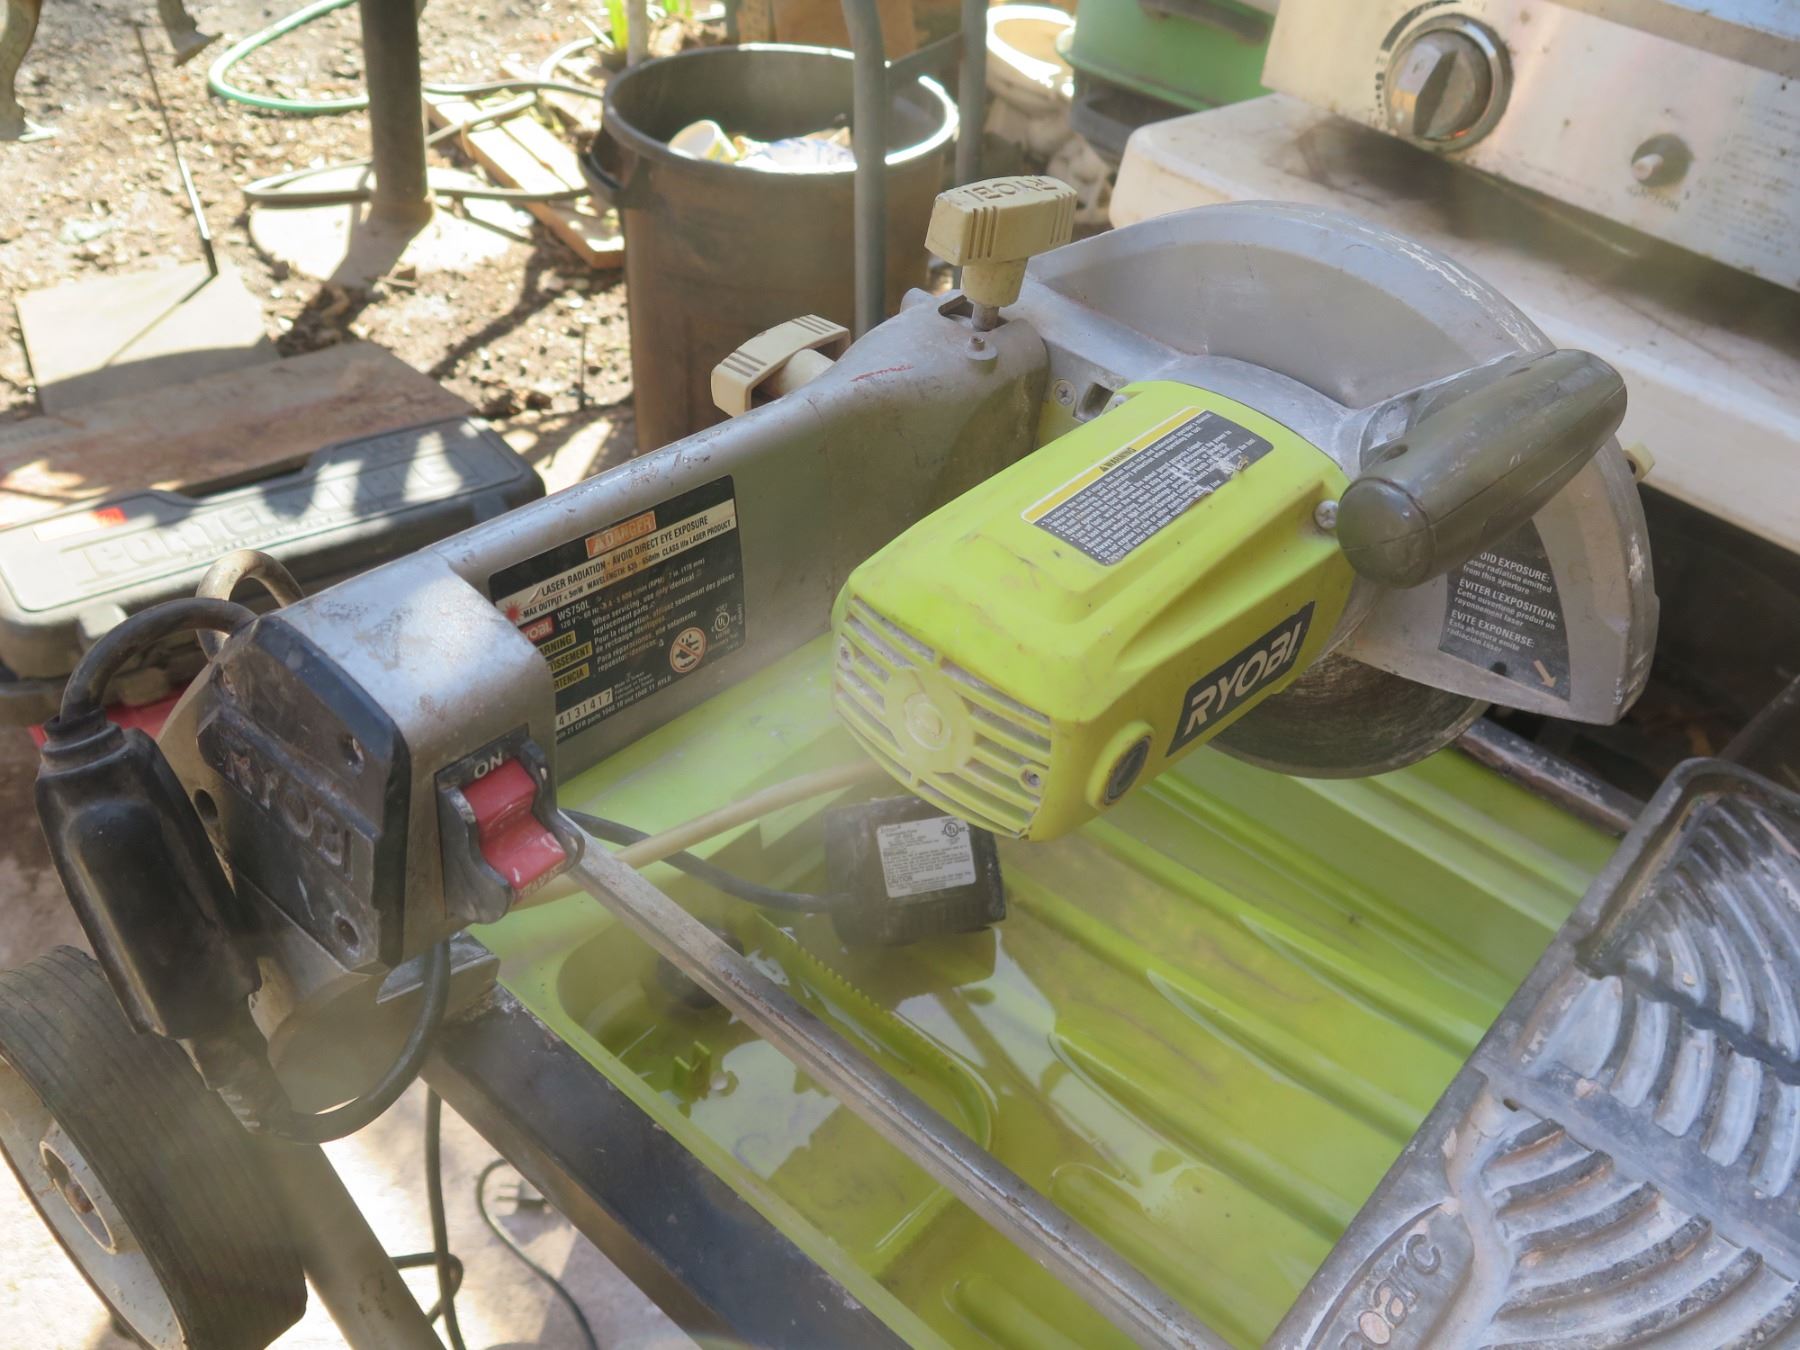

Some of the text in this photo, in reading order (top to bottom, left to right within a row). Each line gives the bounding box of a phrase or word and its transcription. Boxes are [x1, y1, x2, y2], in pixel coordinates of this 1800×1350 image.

[523, 606, 537, 617] MAX
[538, 595, 562, 610] OUTPUT
[661, 543, 679, 556] CLASS
[689, 531, 706, 543] LASER
[706, 520, 731, 535] PRODUCT
[541, 516, 708, 596] LASER RADIATION AVOID DIRECT EYE EXPOSURE
[1480, 552, 1550, 582] OID EXPOSURE:
[1463, 566, 1480, 576] from
[1482, 572, 1495, 582] this
[1487, 565, 1521, 581] radiation
[1523, 577, 1551, 591] emitted
[591, 612, 610, 626] When
[643, 591, 654, 602] use
[670, 574, 694, 589] identical
[1457, 588, 1476, 600] Cette
[557, 599, 589, 621] WS750L
[593, 604, 648, 635] replacement parts
[1455, 597, 1502, 618] rayonnement
[539, 635, 571, 657] ARNING
[594, 633, 608, 644] Pour
[1478, 620, 1534, 647] EXPONERSE:
[550, 645, 589, 671] ISSEMENT
[596, 652, 612, 663] Para
[554, 668, 584, 689] RTENCIA
[1183, 621, 1303, 737] RYOBI
[474, 752, 503, 779] ON
[222, 750, 354, 880] RYOBI
